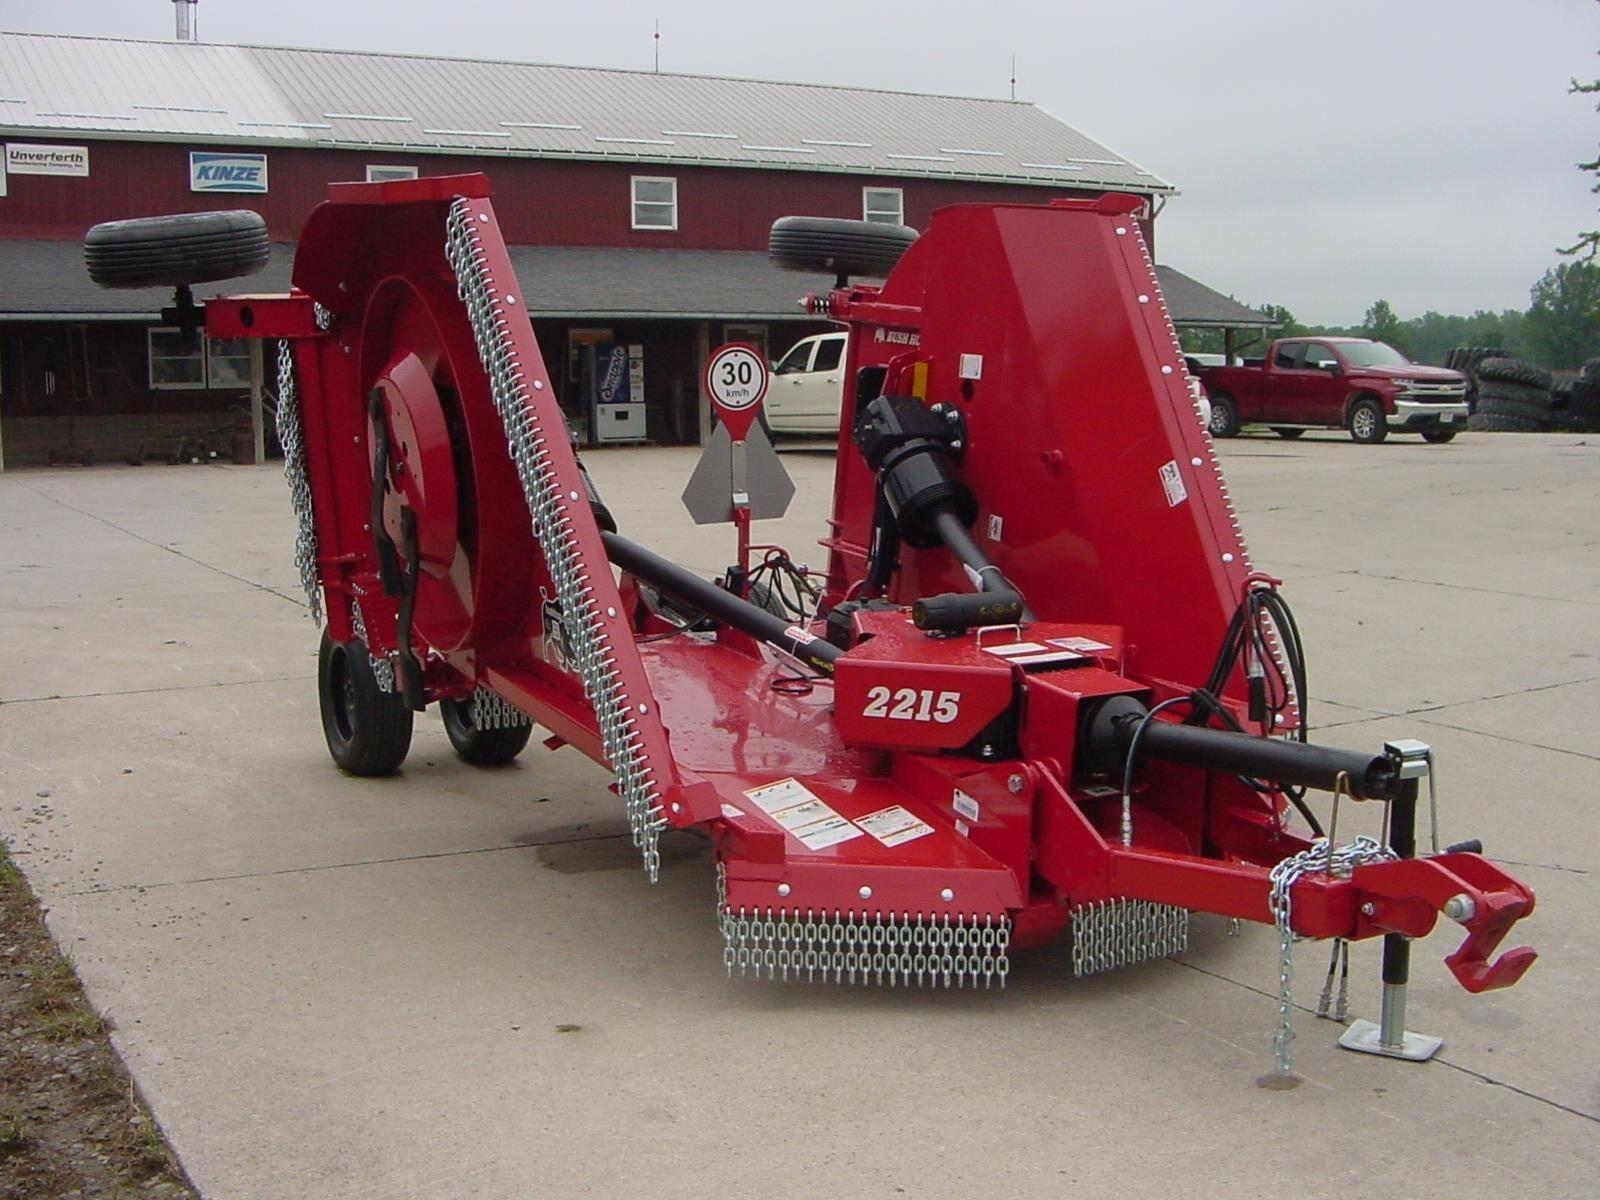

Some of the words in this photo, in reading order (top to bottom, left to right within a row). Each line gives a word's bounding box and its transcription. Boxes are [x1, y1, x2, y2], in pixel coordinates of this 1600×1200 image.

[10, 150, 83, 162] Unverferth
[196, 165, 261, 182] KINZE
[601, 348, 624, 399] Snapple
[721, 361, 752, 386] 30
[726, 388, 750, 398] km/h
[863, 686, 960, 724] 2215
